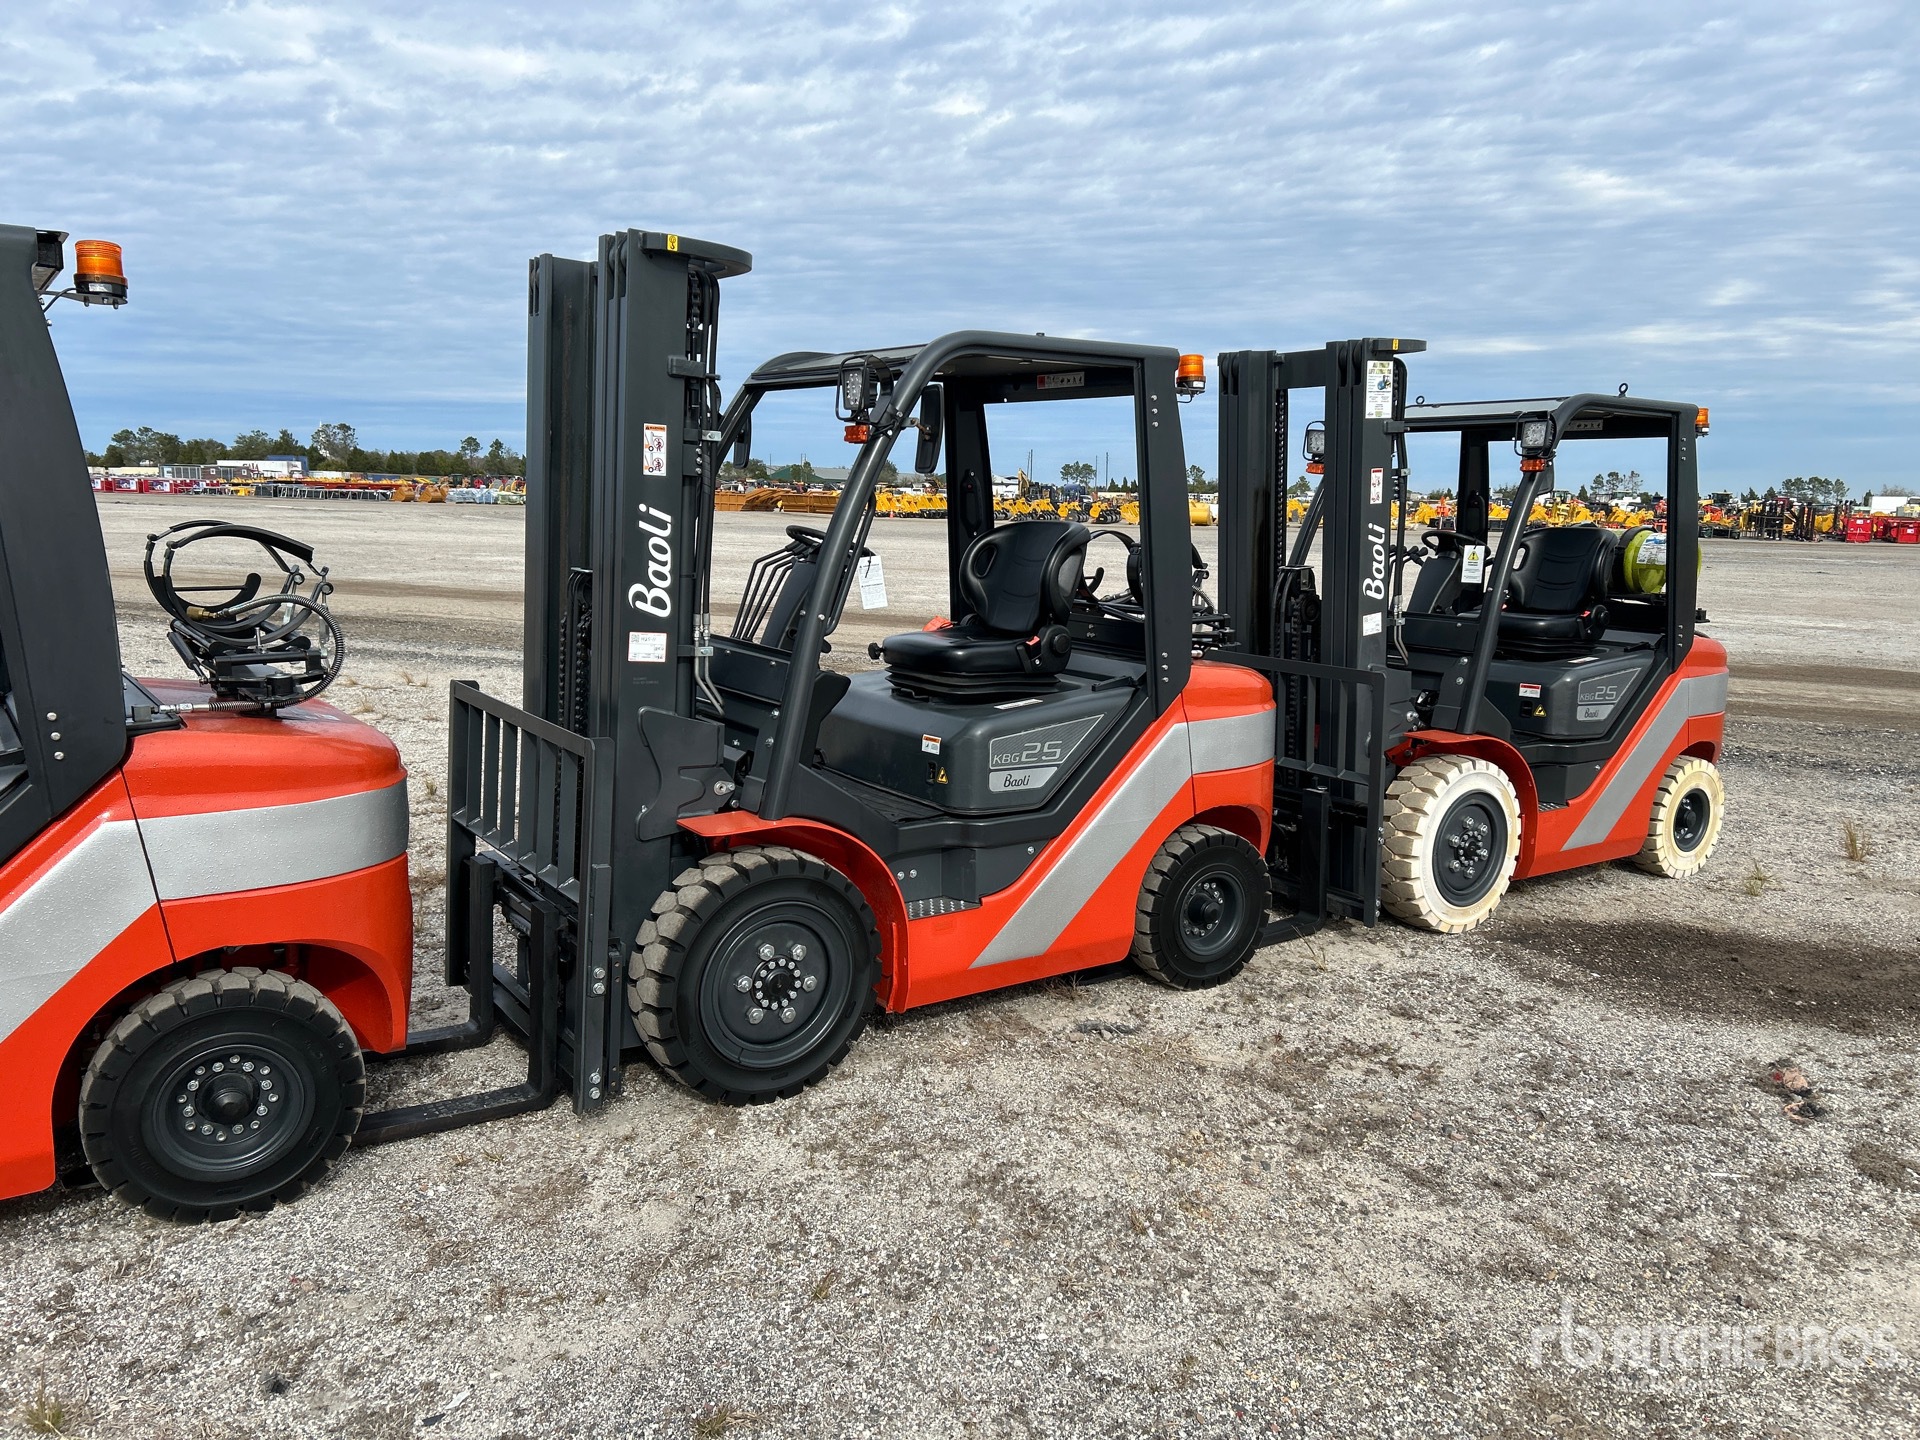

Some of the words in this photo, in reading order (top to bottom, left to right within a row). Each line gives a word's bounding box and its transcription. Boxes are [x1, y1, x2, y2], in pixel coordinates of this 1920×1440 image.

[628, 503, 672, 618] Baoli
[1363, 522, 1386, 600] Baoli
[1003, 773, 1031, 788] Baoli
